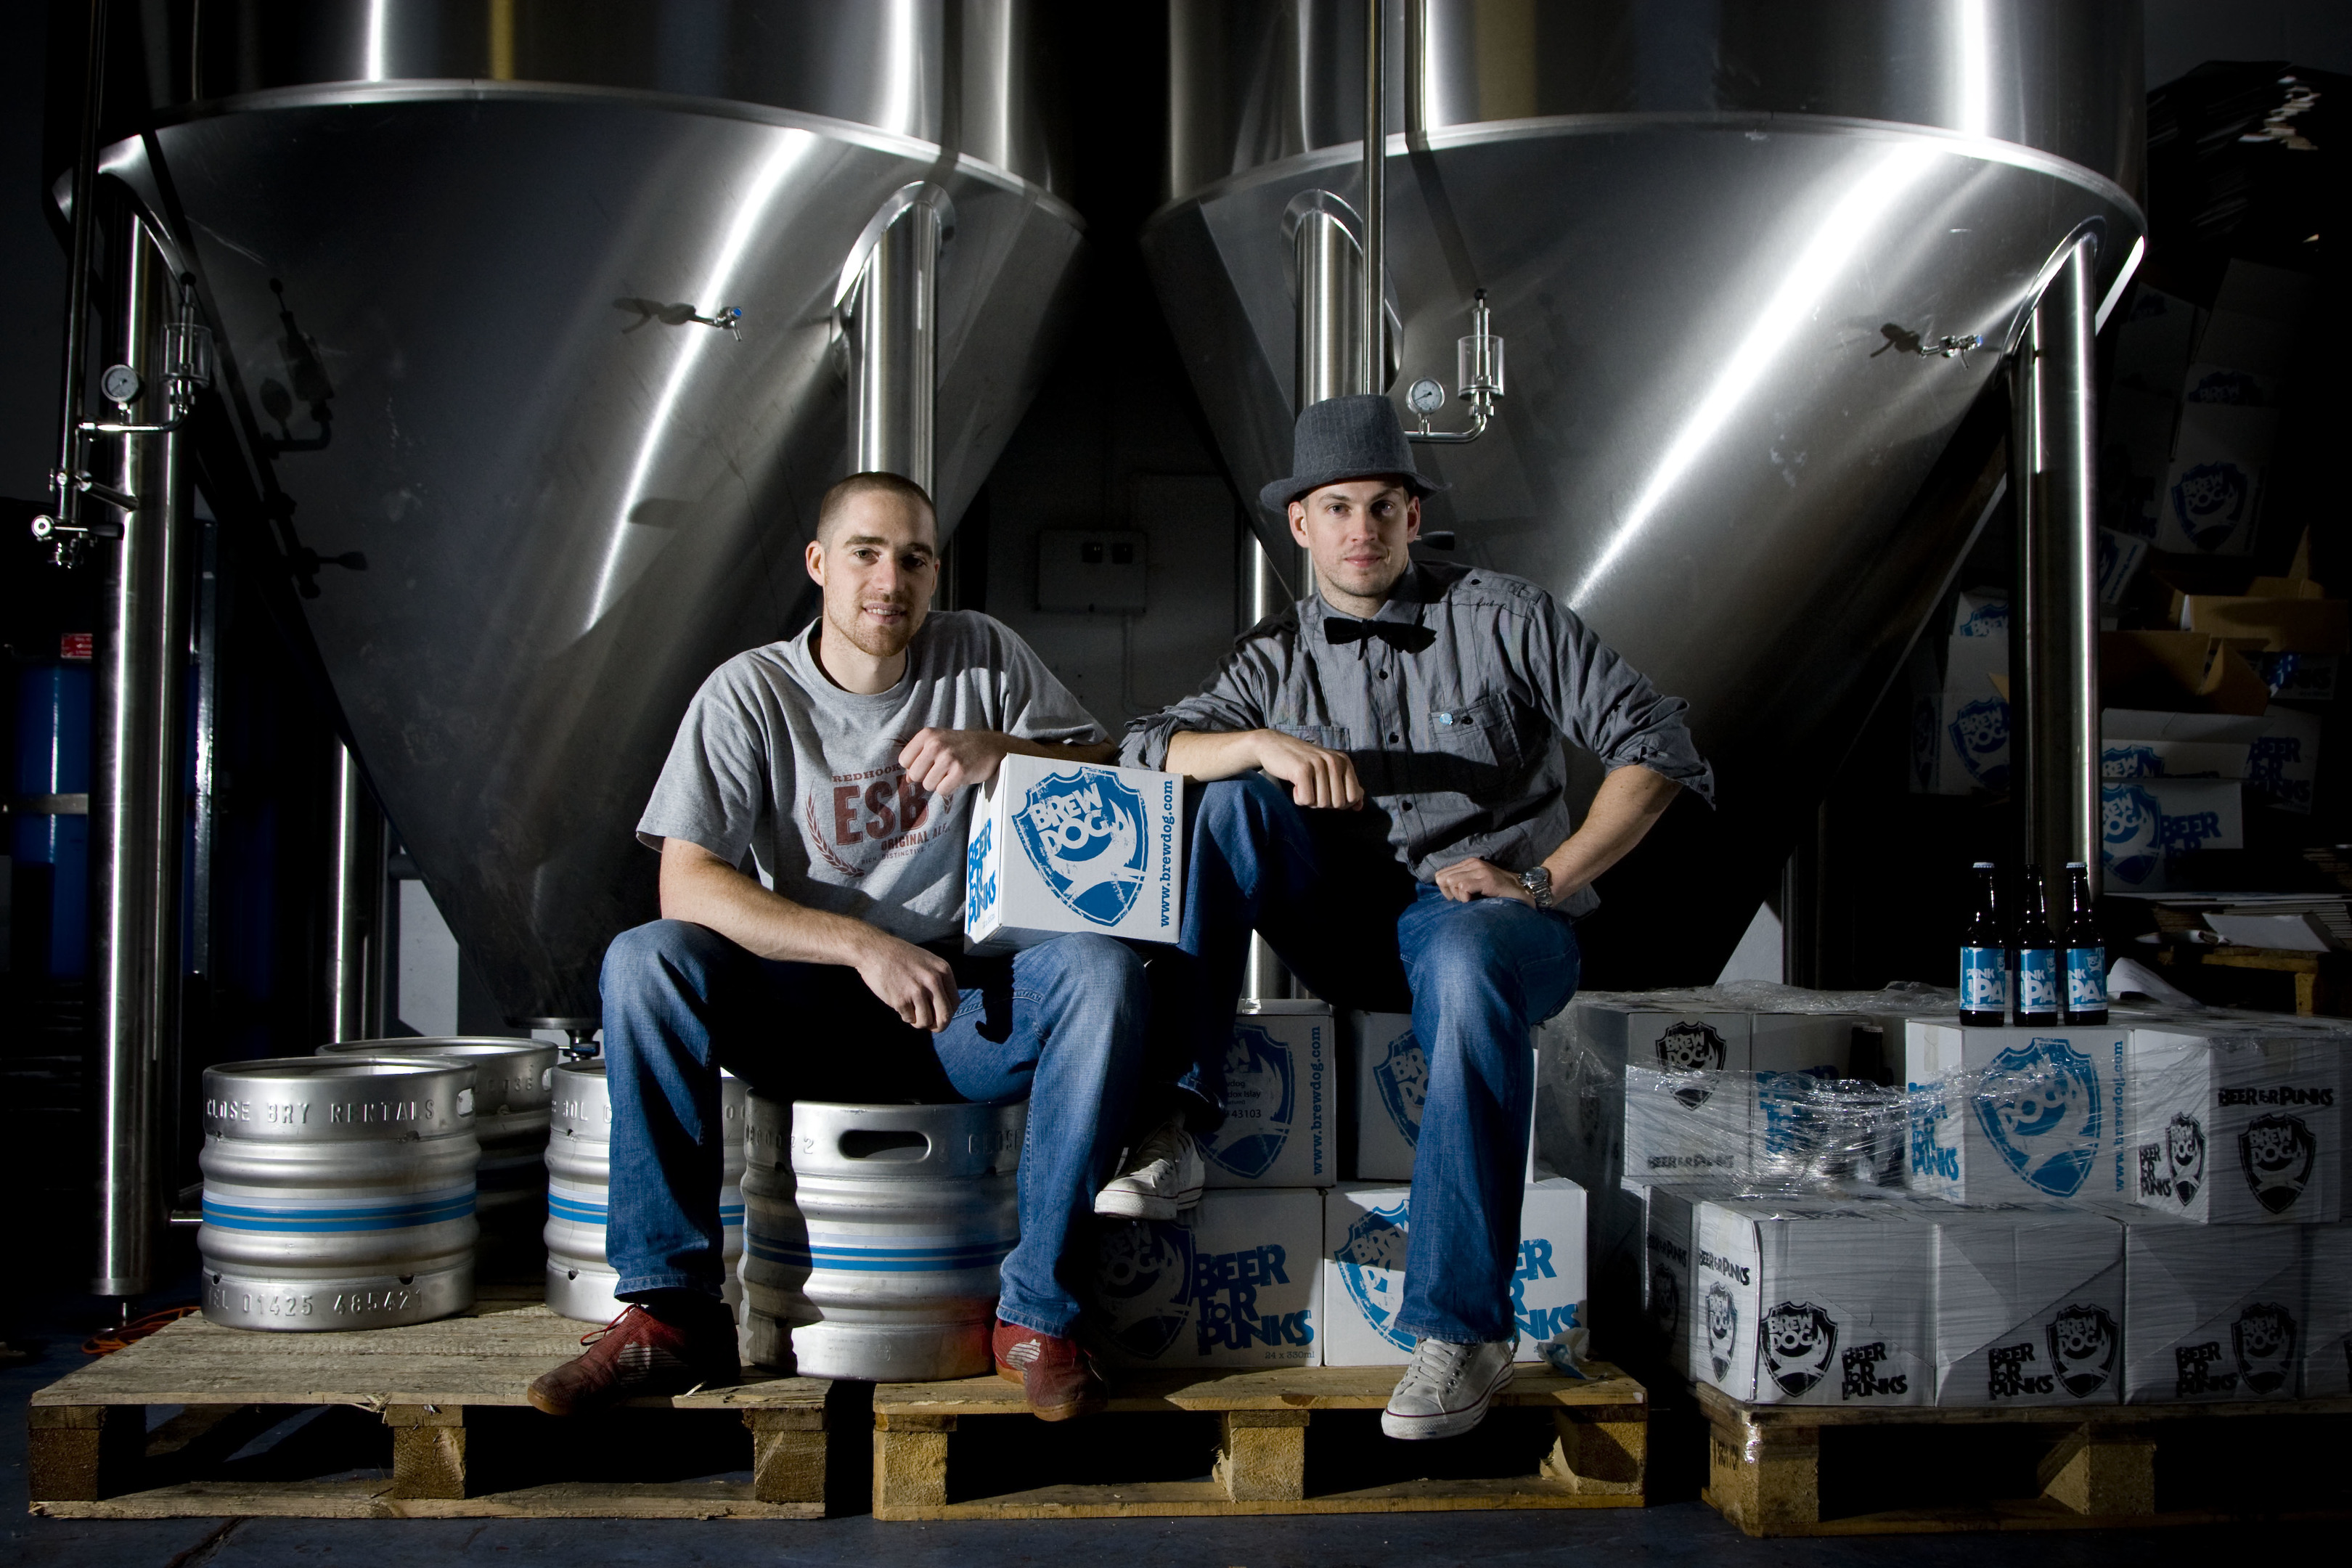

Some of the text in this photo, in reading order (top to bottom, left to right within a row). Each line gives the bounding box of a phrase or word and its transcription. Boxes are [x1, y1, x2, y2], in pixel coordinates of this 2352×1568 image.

[832, 763, 901, 783] REDHOOK
[833, 774, 929, 846] ESB
[1028, 782, 1103, 832] BREW
[881, 830, 929, 852] ORIGINAL
[1039, 809, 1114, 856] DOG
[2160, 812, 2223, 846] BEER
[968, 817, 992, 883] BEER
[1159, 780, 1175, 928] www.brewdog.com
[1966, 968, 1995, 981] PUNK
[2020, 969, 2046, 981] UNK
[2068, 979, 2102, 1005] PA
[1665, 1031, 1705, 1053] BREW
[1311, 1026, 1324, 1176] www.brewdog.com
[2218, 1086, 2334, 1106] BEER FOR PUNKS
[205, 1098, 436, 1124] CLOSE BRY RENTALS
[1231, 1109, 1262, 1119] 43103
[2250, 1124, 2293, 1145] BREW
[2141, 1177, 2172, 1198] PUNKS
[1193, 1244, 1291, 1297] BEER
[1722, 1257, 1750, 1286] PUNKS
[242, 1294, 314, 1317] 01425
[1199, 1282, 1261, 1325] FOR
[1196, 1309, 1315, 1356] PUNKS
[1768, 1312, 1813, 1334] BREW
[2056, 1314, 2097, 1337] BREW
[2240, 1312, 2279, 1335] BREW
[1770, 1328, 1815, 1350] DOG
[2057, 1331, 2103, 1355] DOG
[1286, 1350, 1315, 1360] 330ml
[1841, 1342, 1887, 1368] BEER
[1988, 1342, 2035, 1368] BEER
[2176, 1342, 2223, 1368] BEER
[1844, 1360, 1876, 1384] FOR
[1841, 1375, 1908, 1400] PUNKS
[1988, 1374, 2055, 1400] PUNKS
[2176, 1372, 2239, 1398] PUNKS
